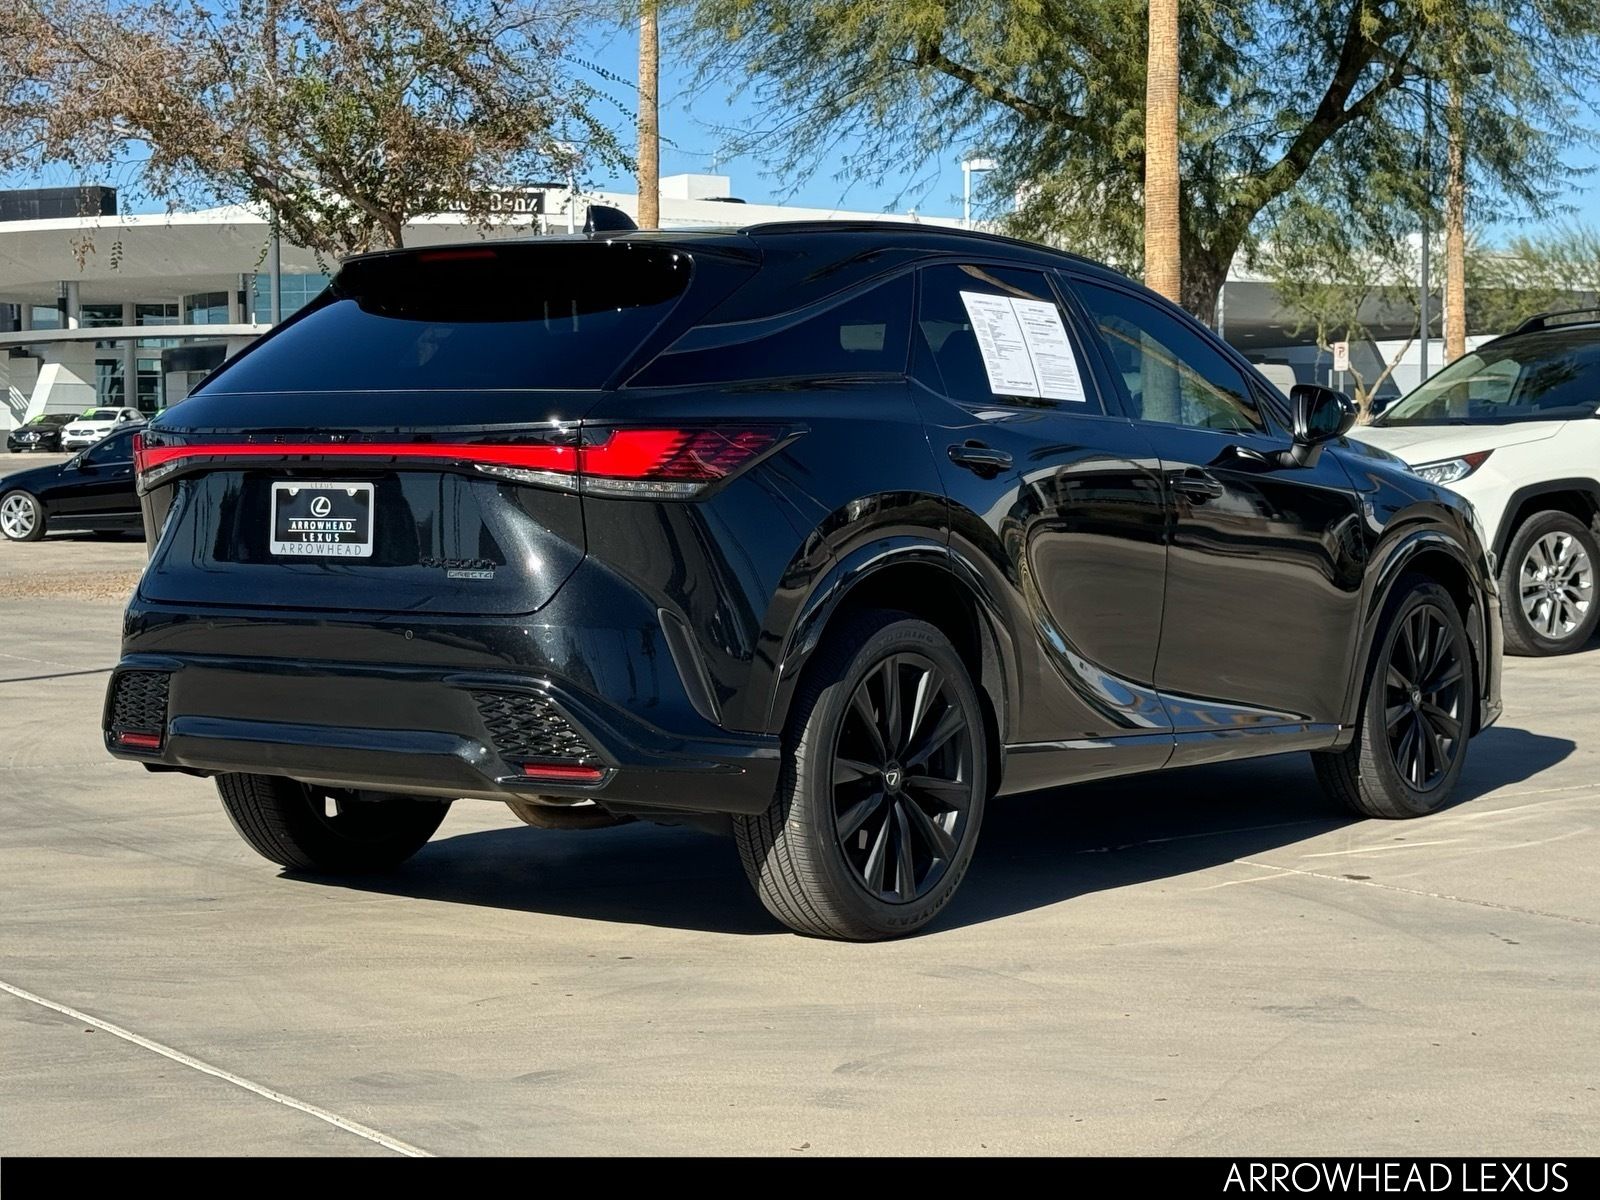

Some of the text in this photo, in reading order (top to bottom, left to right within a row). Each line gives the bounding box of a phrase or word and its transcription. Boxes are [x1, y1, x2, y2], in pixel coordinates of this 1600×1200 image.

[291, 521, 353, 531] ARROWHEAD
[302, 533, 340, 542] LEXUS
[280, 543, 362, 556] ARROWHEAD
